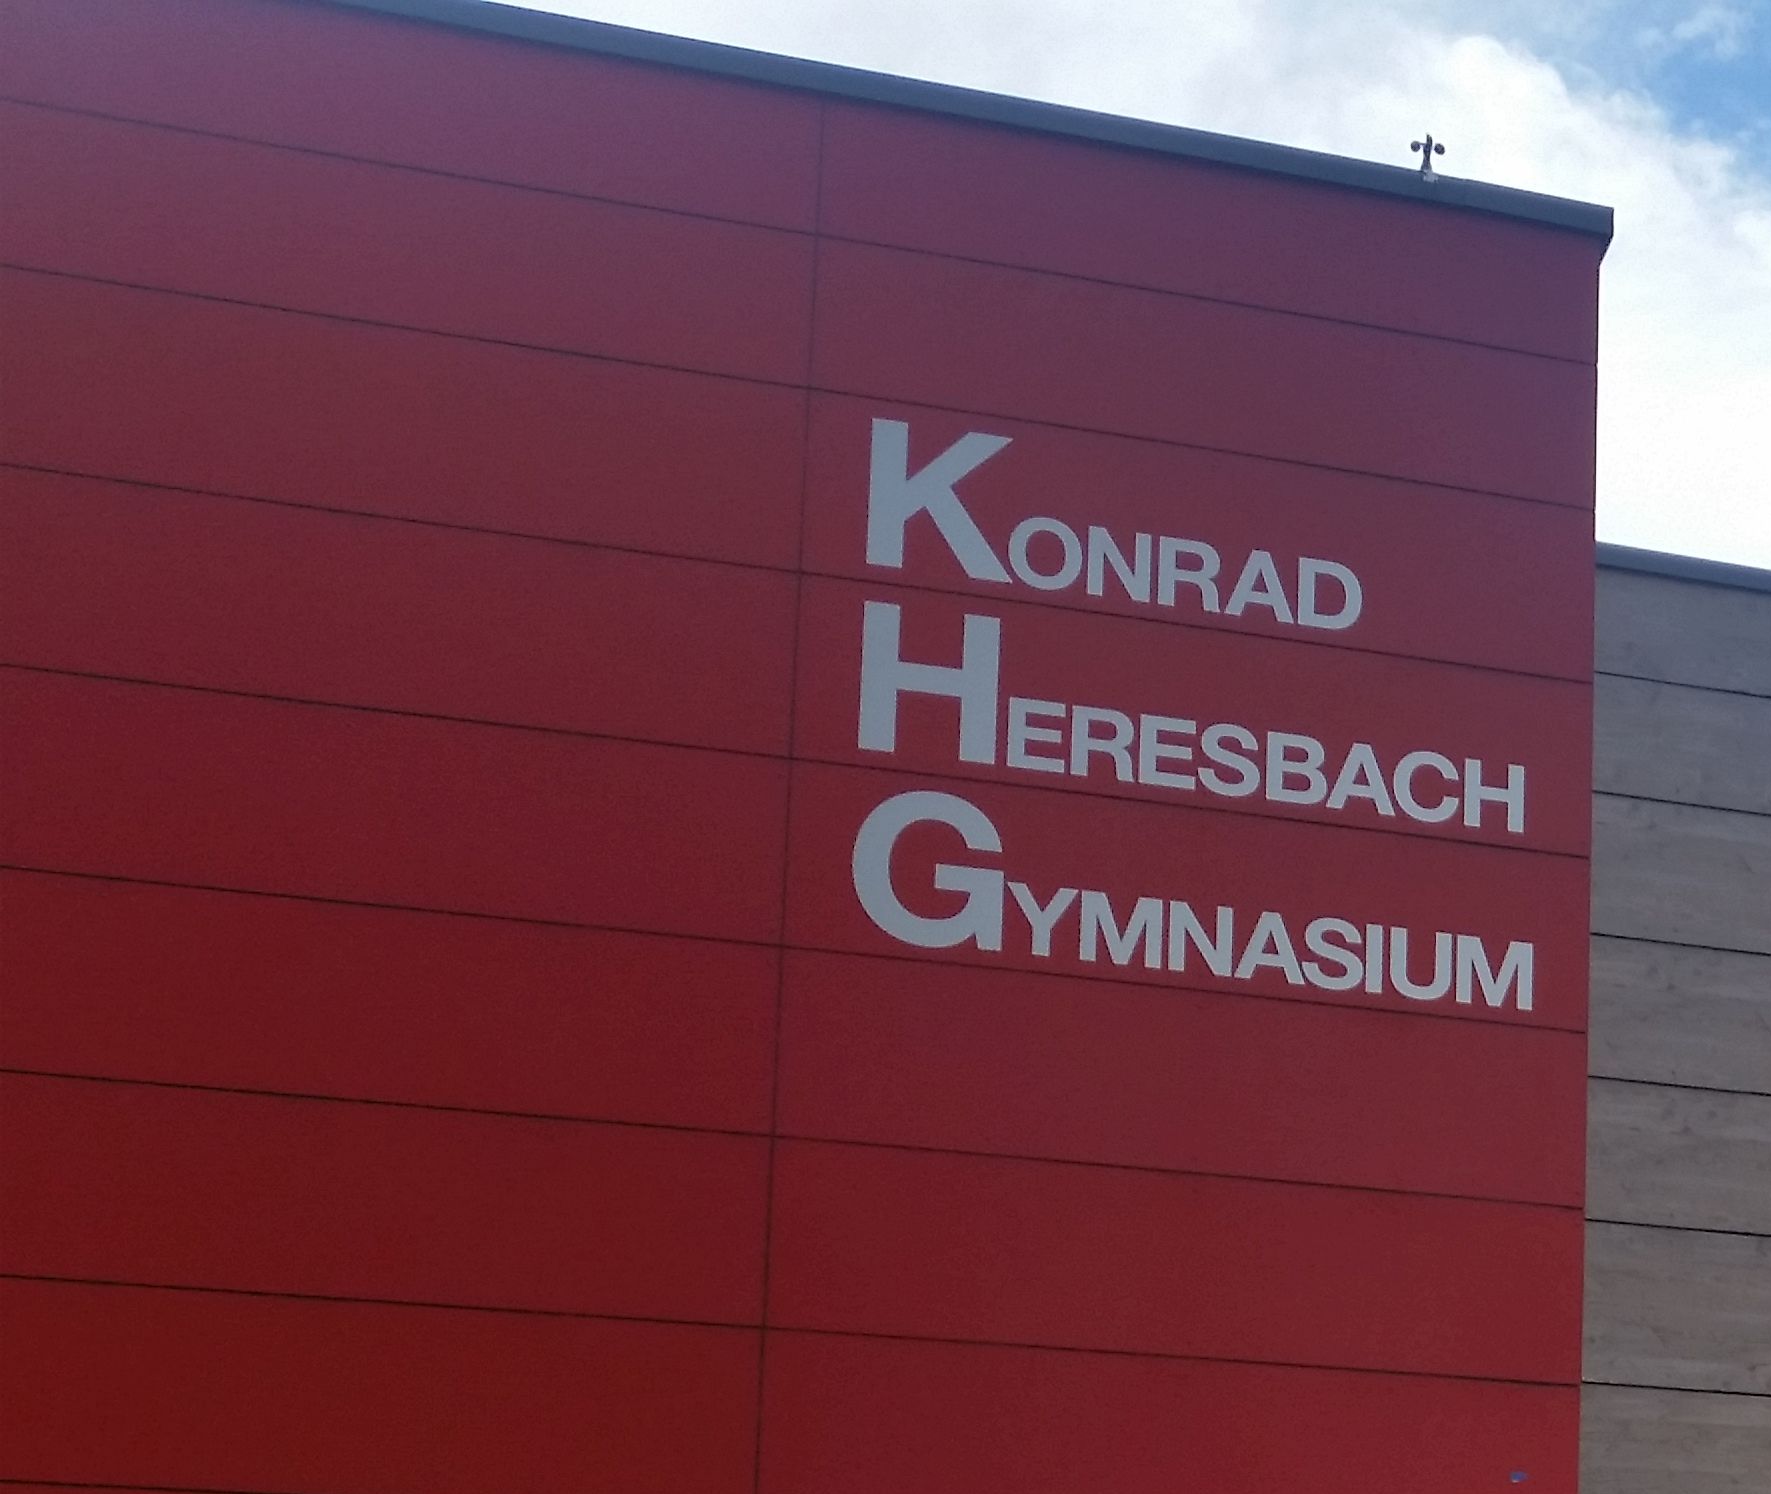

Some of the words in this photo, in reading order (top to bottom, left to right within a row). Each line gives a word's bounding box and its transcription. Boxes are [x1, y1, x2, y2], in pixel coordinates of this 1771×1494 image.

[865, 417, 1363, 630] KONRAD
[857, 600, 1525, 833] HERESBACH
[852, 790, 1534, 1011] GYMNASIUM
